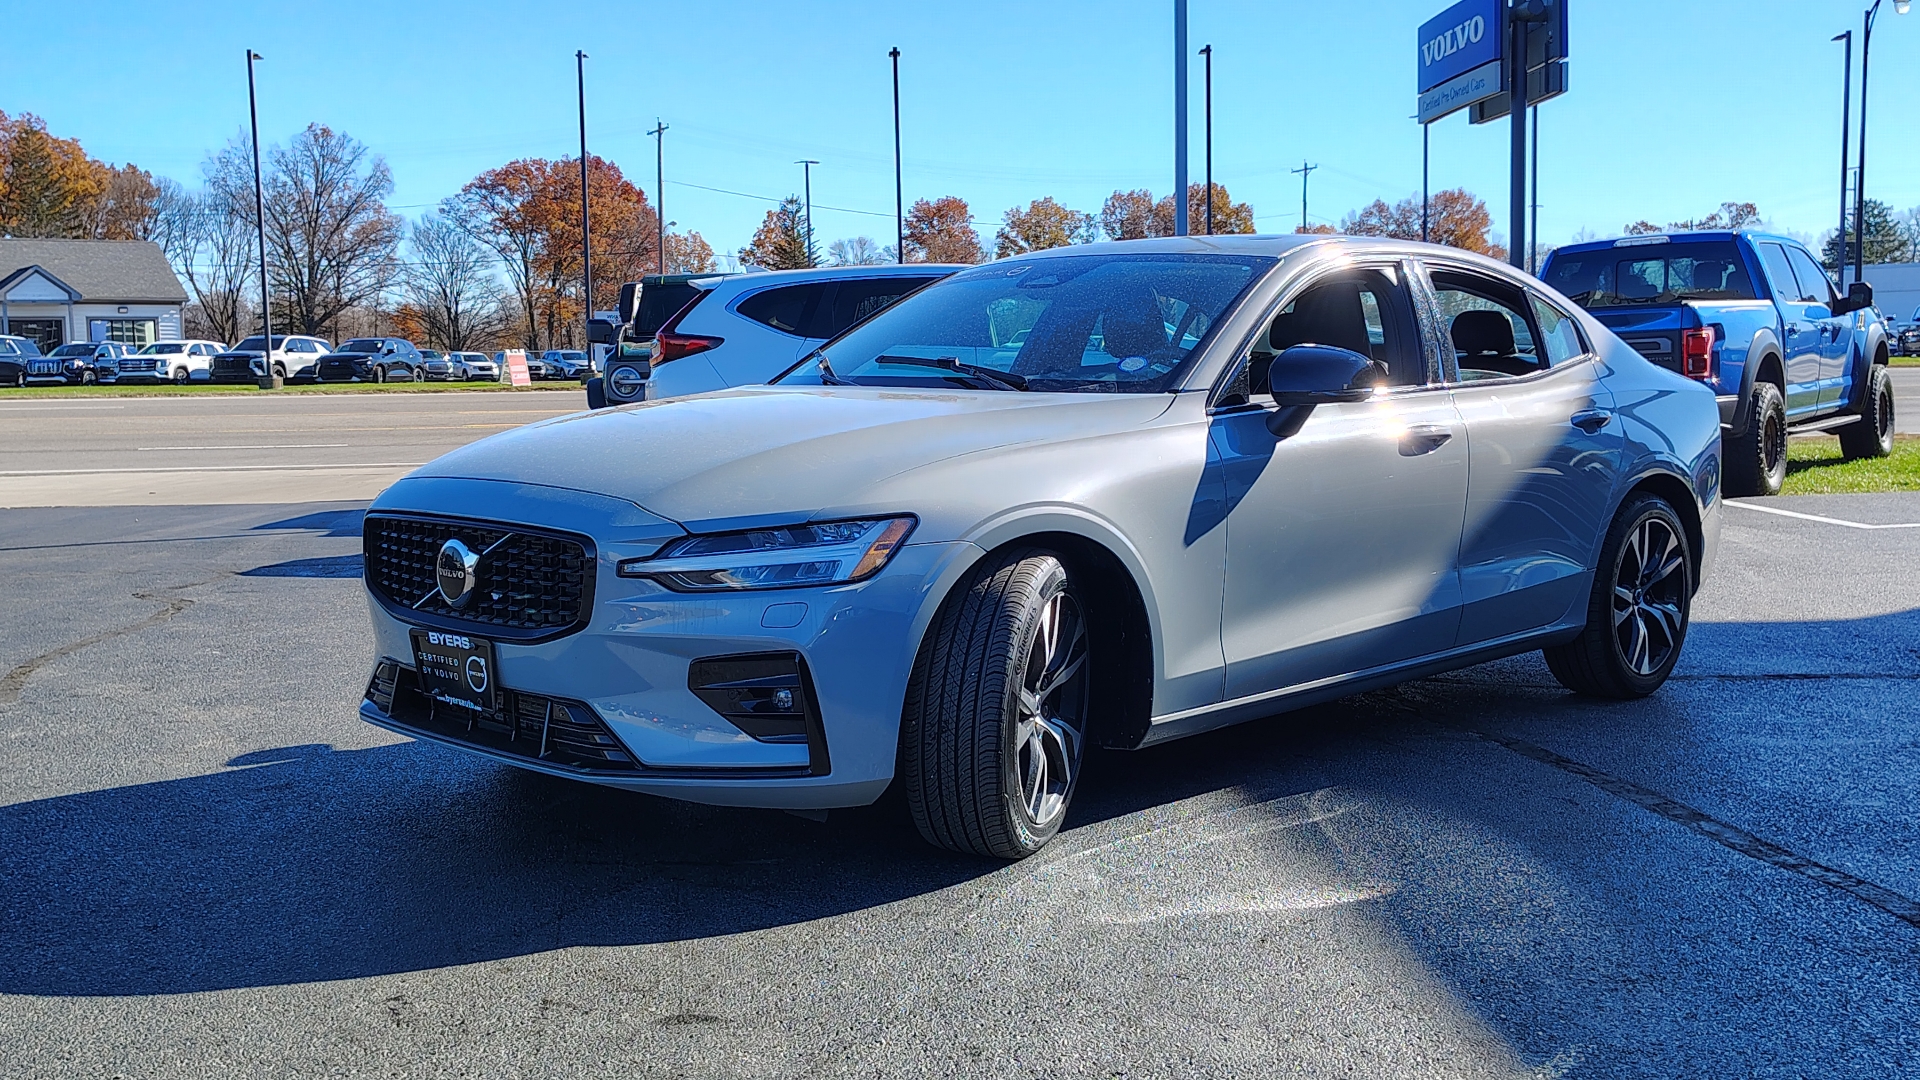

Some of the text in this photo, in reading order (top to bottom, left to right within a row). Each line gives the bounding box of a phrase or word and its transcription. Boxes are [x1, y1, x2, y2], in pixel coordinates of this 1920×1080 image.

[1421, 15, 1485, 67] VOLVO
[1450, 80, 1470, 100] Owned
[1470, 78, 1486, 92] Cars
[438, 567, 465, 579] VOLVO
[428, 632, 471, 650] BYERS
[418, 651, 459, 668] CERTIFIED
[422, 665, 459, 681] BY VOLVO
